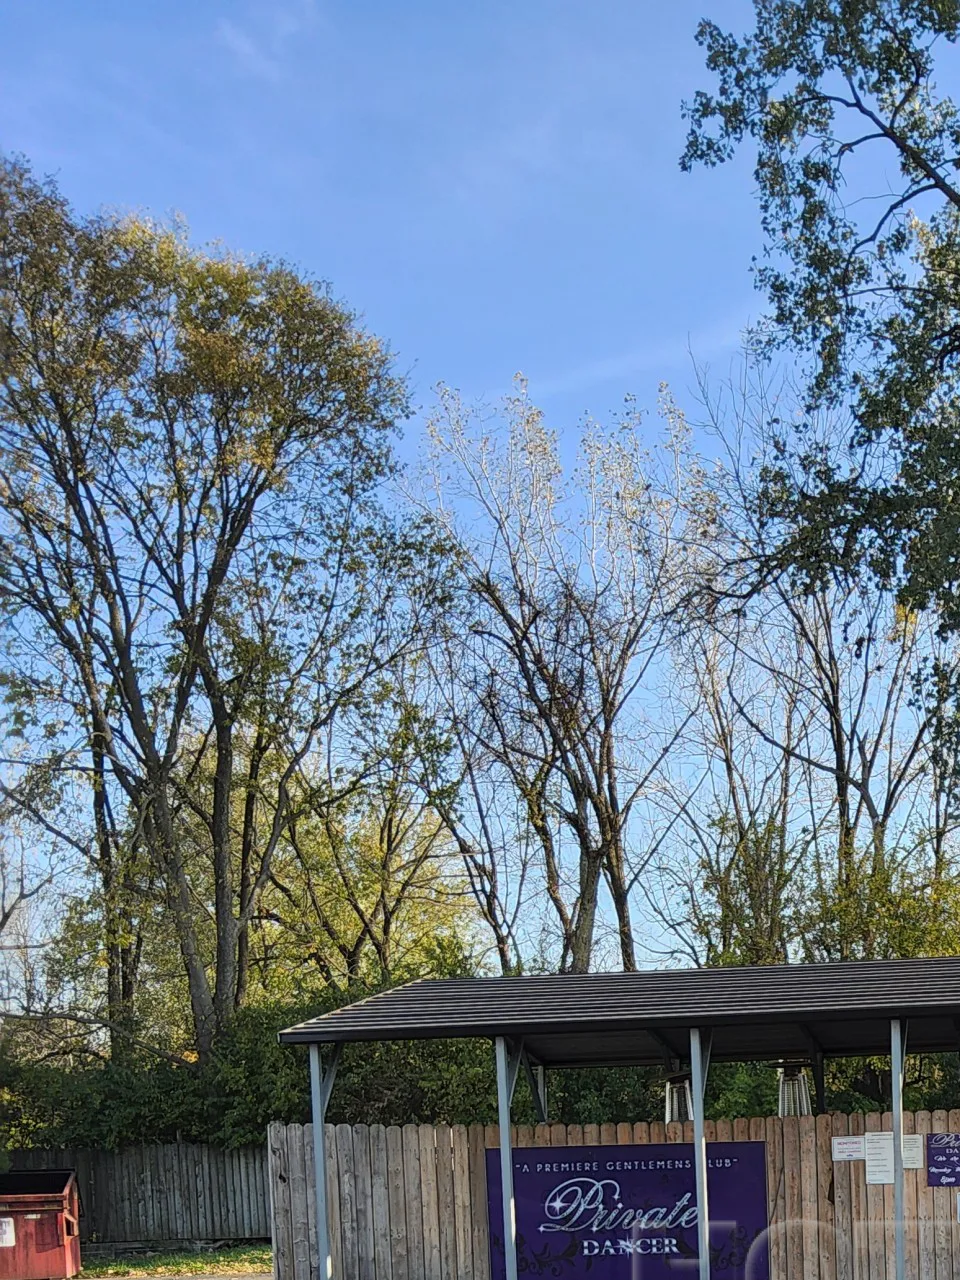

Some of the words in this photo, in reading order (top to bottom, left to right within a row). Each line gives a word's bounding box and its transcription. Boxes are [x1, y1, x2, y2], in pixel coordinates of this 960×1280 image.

[537, 1161, 599, 1172] PREMIERE
[606, 1159, 692, 1170] GENTLEMENS
[708, 1158, 738, 1168] LUB"
[538, 1177, 700, 1232] Private
[582, 1237, 680, 1257] DANCER
